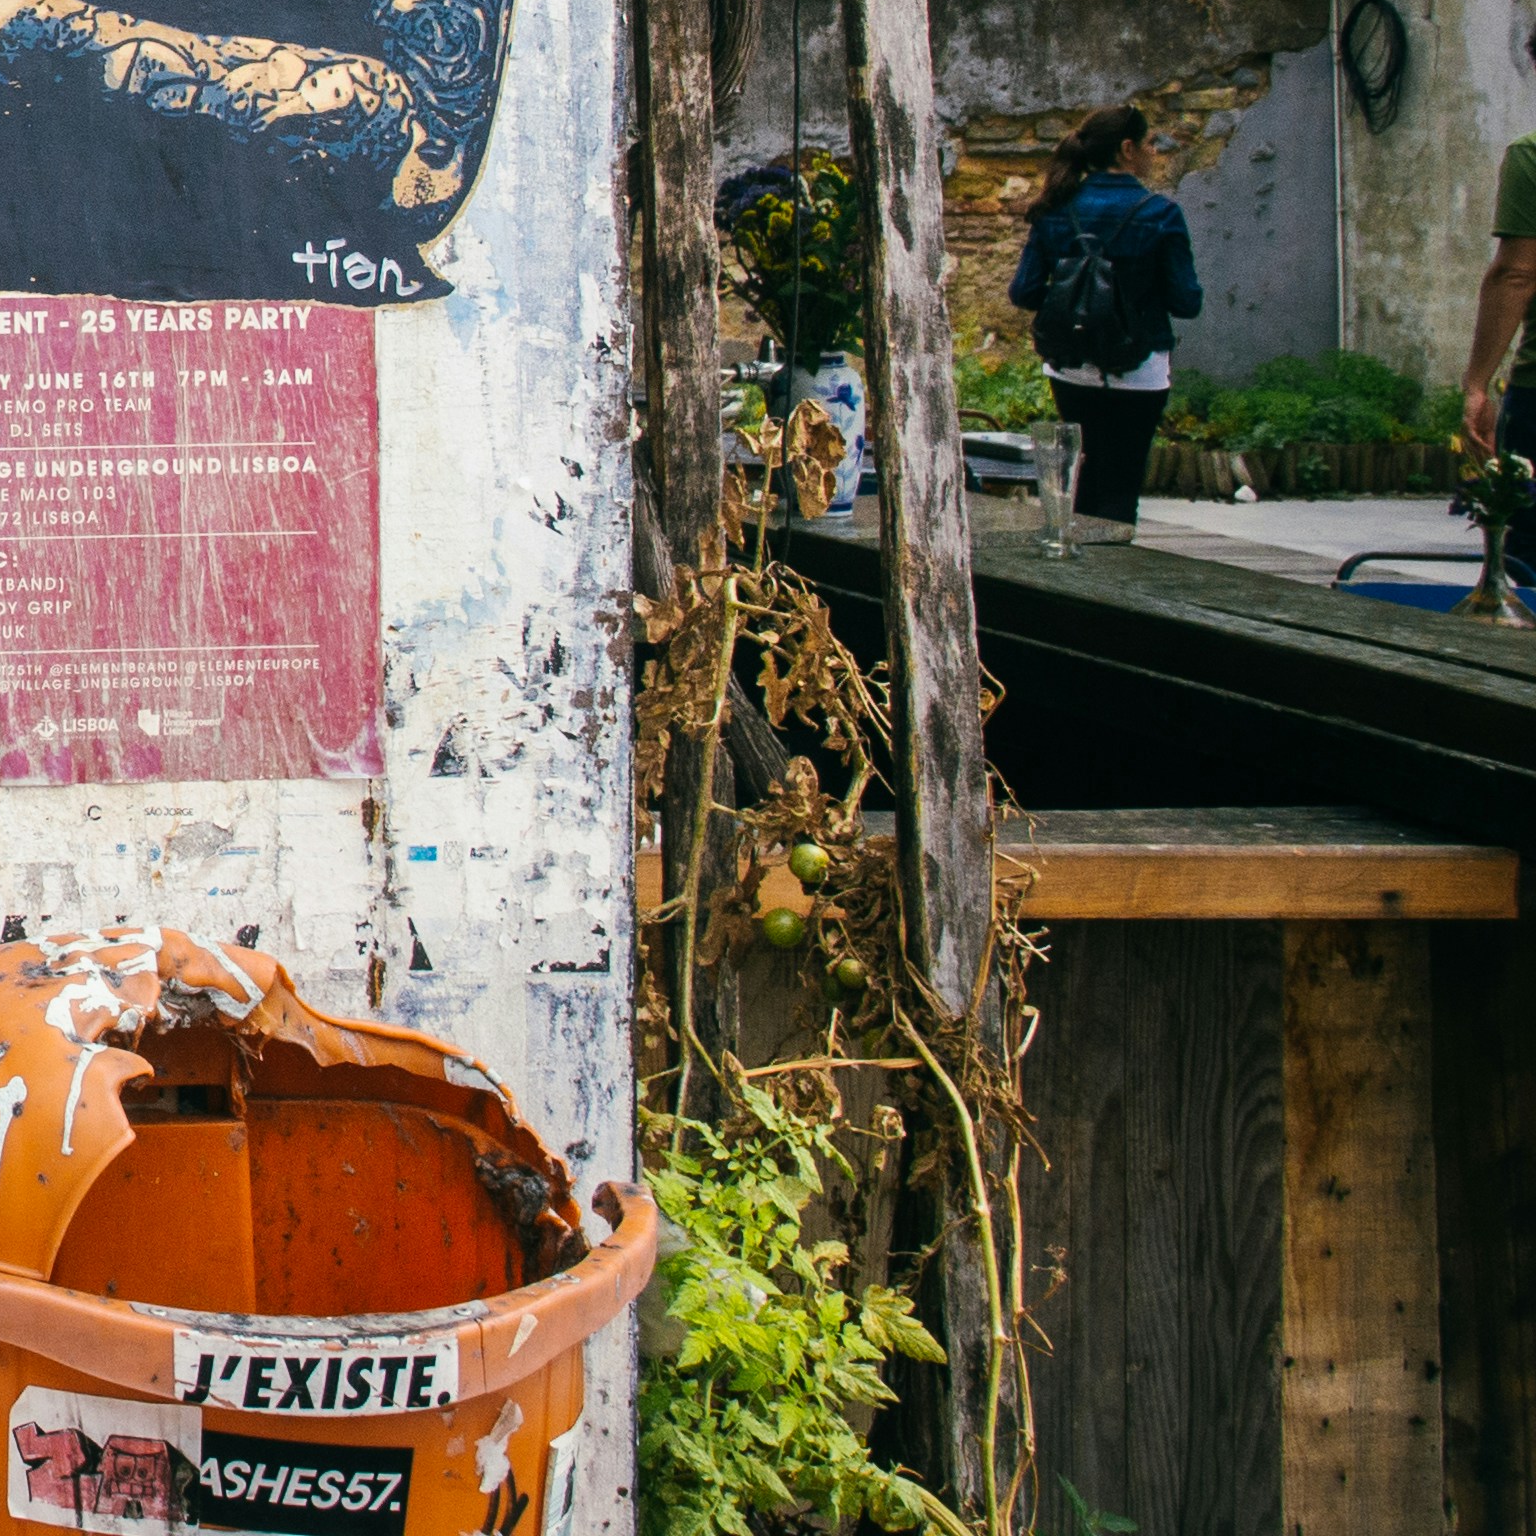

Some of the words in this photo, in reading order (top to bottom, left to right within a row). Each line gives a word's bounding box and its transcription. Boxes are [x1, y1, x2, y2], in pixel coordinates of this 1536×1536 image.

[81, 310, 116, 334] 25
[126, 308, 213, 332] YEARS
[225, 306, 312, 330] PARTY
[24, 372, 84, 390] JUNE
[99, 371, 155, 388] 16TH
[178, 370, 228, 387] 7PM
[263, 368, 313, 385] 3AM
[56, 399, 95, 413] PRO
[104, 398, 152, 412] TEAM
[10, 424, 32, 438] DJ
[42, 423, 83, 437] SETS
[34, 456, 222, 478] UNDERGROUND
[230, 455, 318, 474] LISBOA
[20, 487, 71, 501] MAIO
[82, 486, 116, 500] 103
[32, 511, 99, 525] LISBOA
[27, 600, 73, 615] GRIP
[49, 661, 178, 677] @ELEMENTBRAND
[185, 658, 320, 673] @ELEMENTEUROPE
[63, 718, 119, 733] LISBOA
